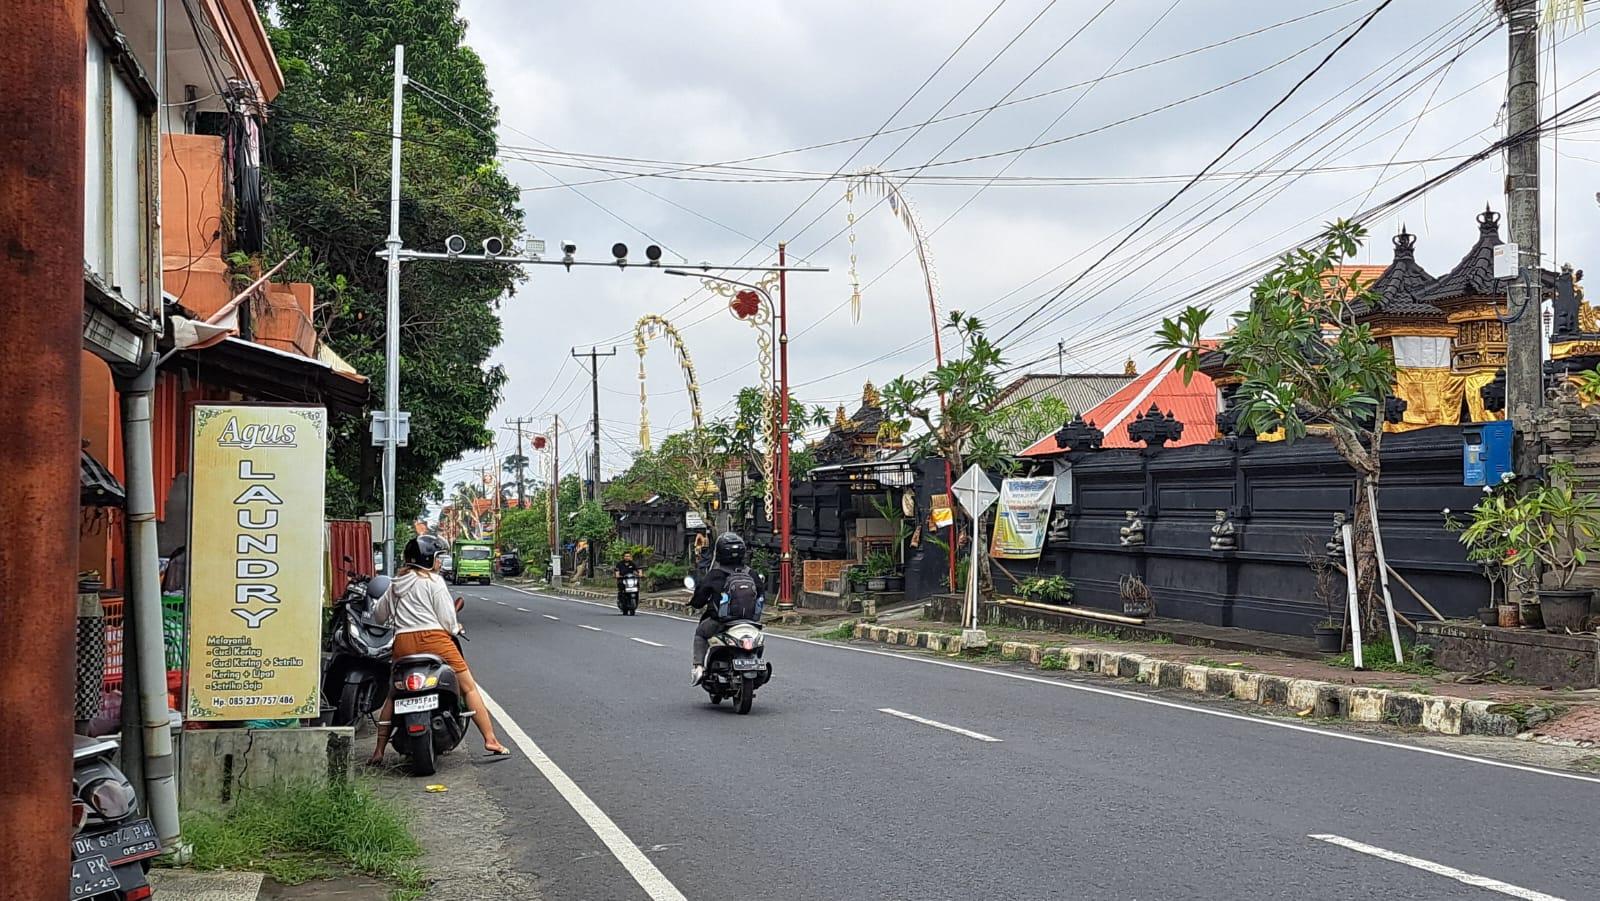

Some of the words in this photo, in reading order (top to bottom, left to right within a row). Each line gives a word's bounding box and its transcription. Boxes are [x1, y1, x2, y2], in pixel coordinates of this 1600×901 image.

[217, 416, 297, 449] Agus
[231, 459, 284, 629] LAUNDRY
[212, 647, 232, 656] Cuci
[233, 647, 262, 657] Kering
[212, 659, 232, 668] Cuci
[233, 658, 261, 668] Kering
[212, 670, 240, 680] Kering
[252, 669, 274, 679] Lipat
[229, 697, 243, 705] 085
[263, 696, 277, 704] 757
[279, 695, 294, 704] 486
[75, 839, 94, 854] DK
[87, 858, 109, 875] PK
